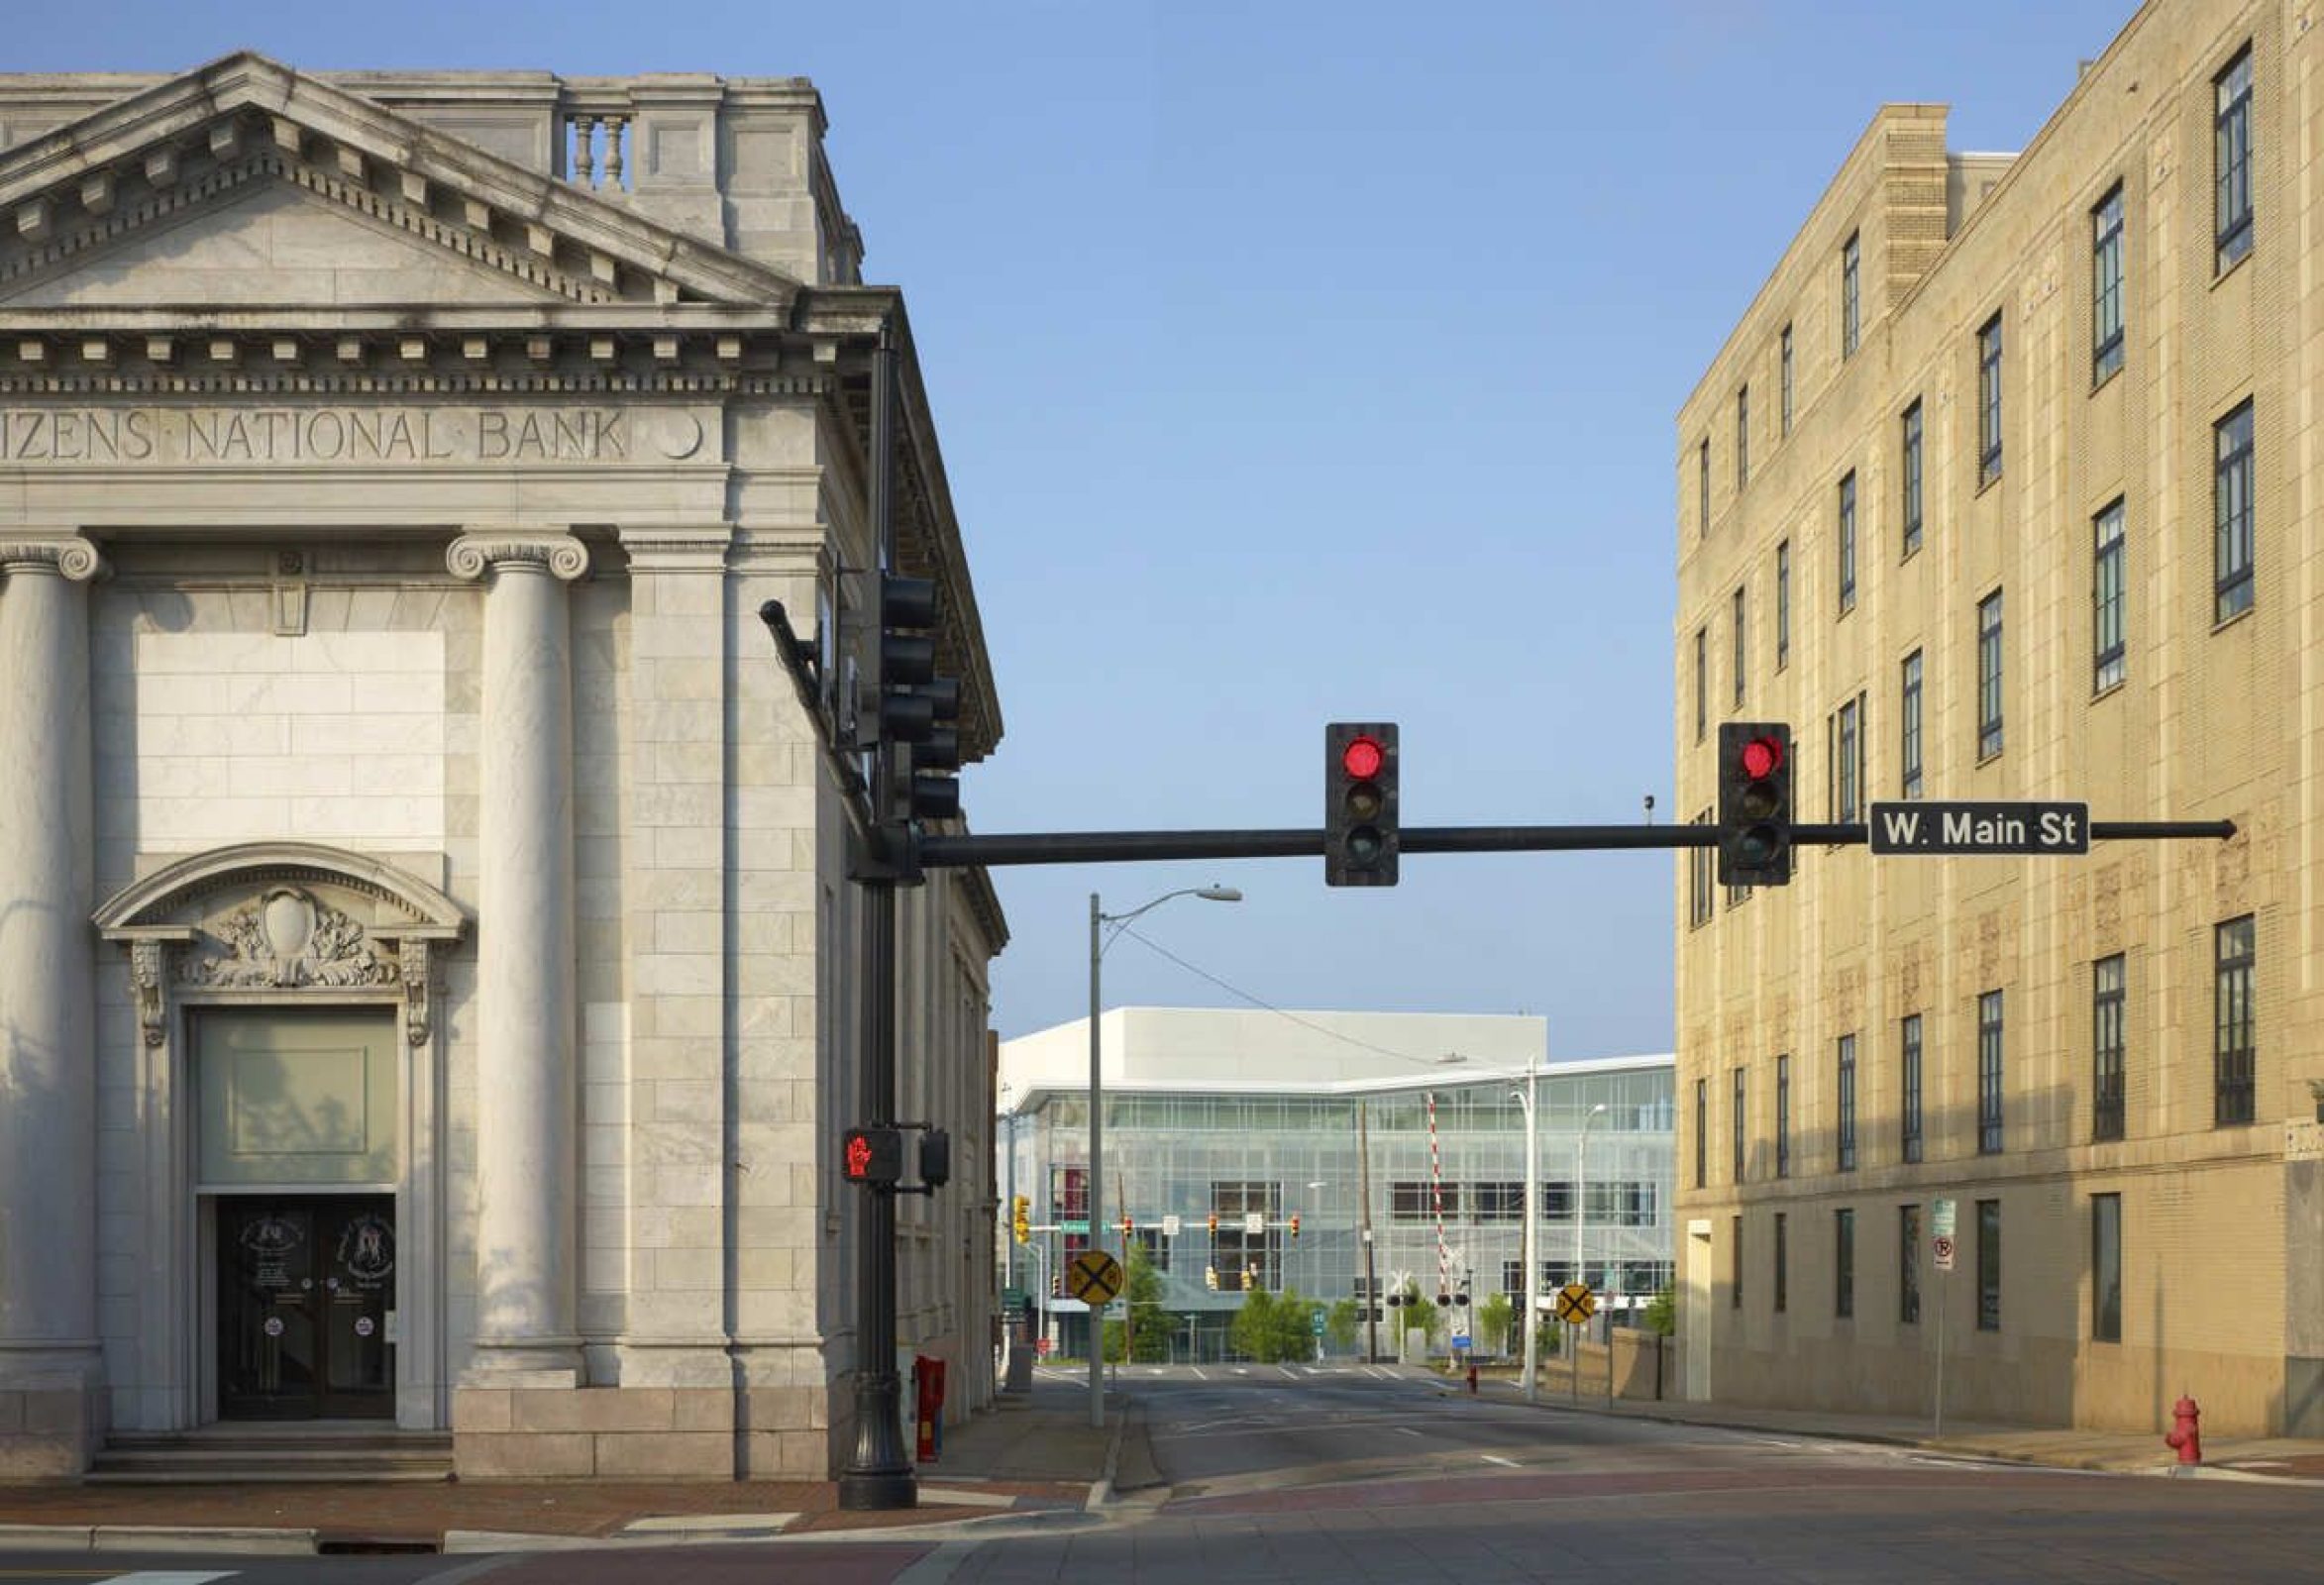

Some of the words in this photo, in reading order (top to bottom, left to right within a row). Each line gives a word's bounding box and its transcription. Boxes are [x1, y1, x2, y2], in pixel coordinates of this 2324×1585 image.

[185, 410, 453, 460] NATIONAL
[477, 410, 626, 460] BANK
[1883, 811, 1929, 845] W.
[1943, 811, 2026, 845] Main
[2039, 810, 2076, 845] St
